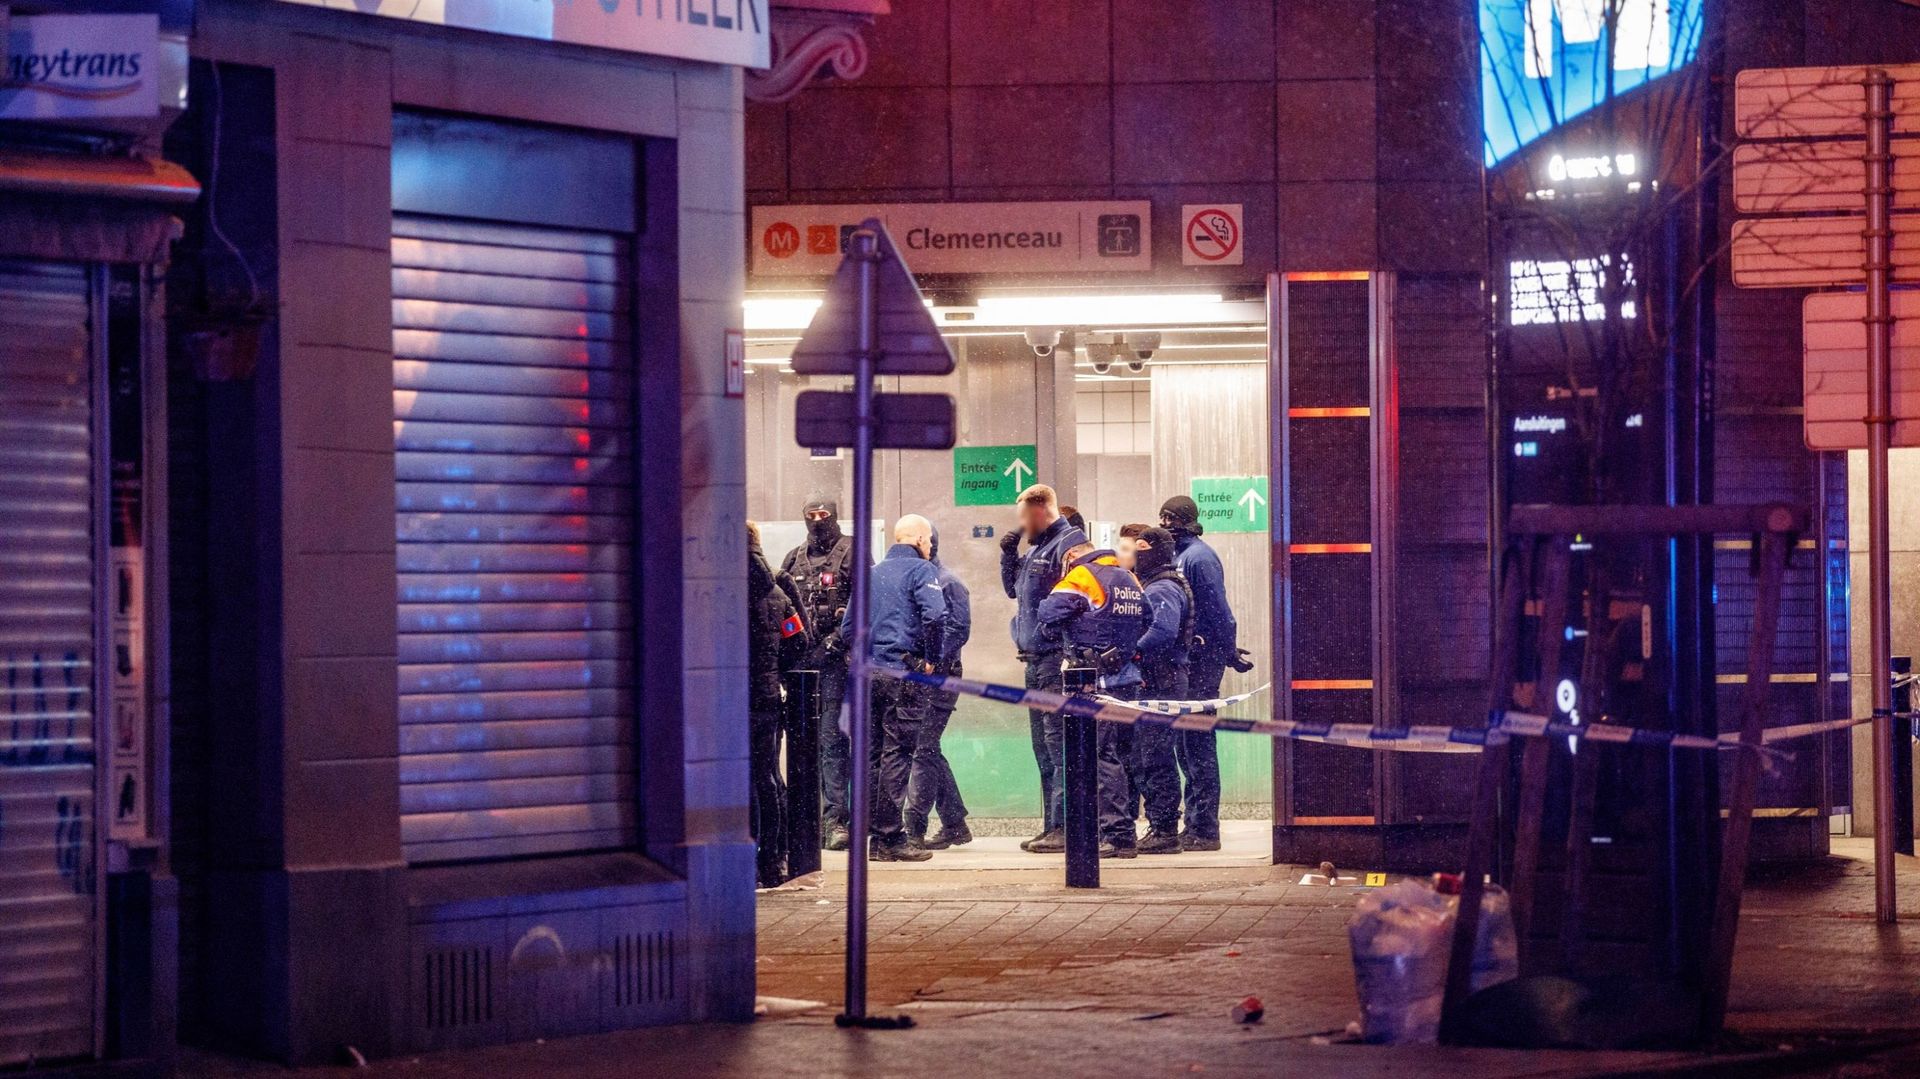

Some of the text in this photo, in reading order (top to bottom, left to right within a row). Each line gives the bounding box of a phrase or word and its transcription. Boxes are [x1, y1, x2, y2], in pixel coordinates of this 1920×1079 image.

[906, 228, 1062, 250] Clemenceau
[961, 462, 998, 474] Entrée
[1198, 491, 1232, 503] Entrée
[1114, 586, 1141, 601] Police
[1112, 602, 1143, 616] Politie
